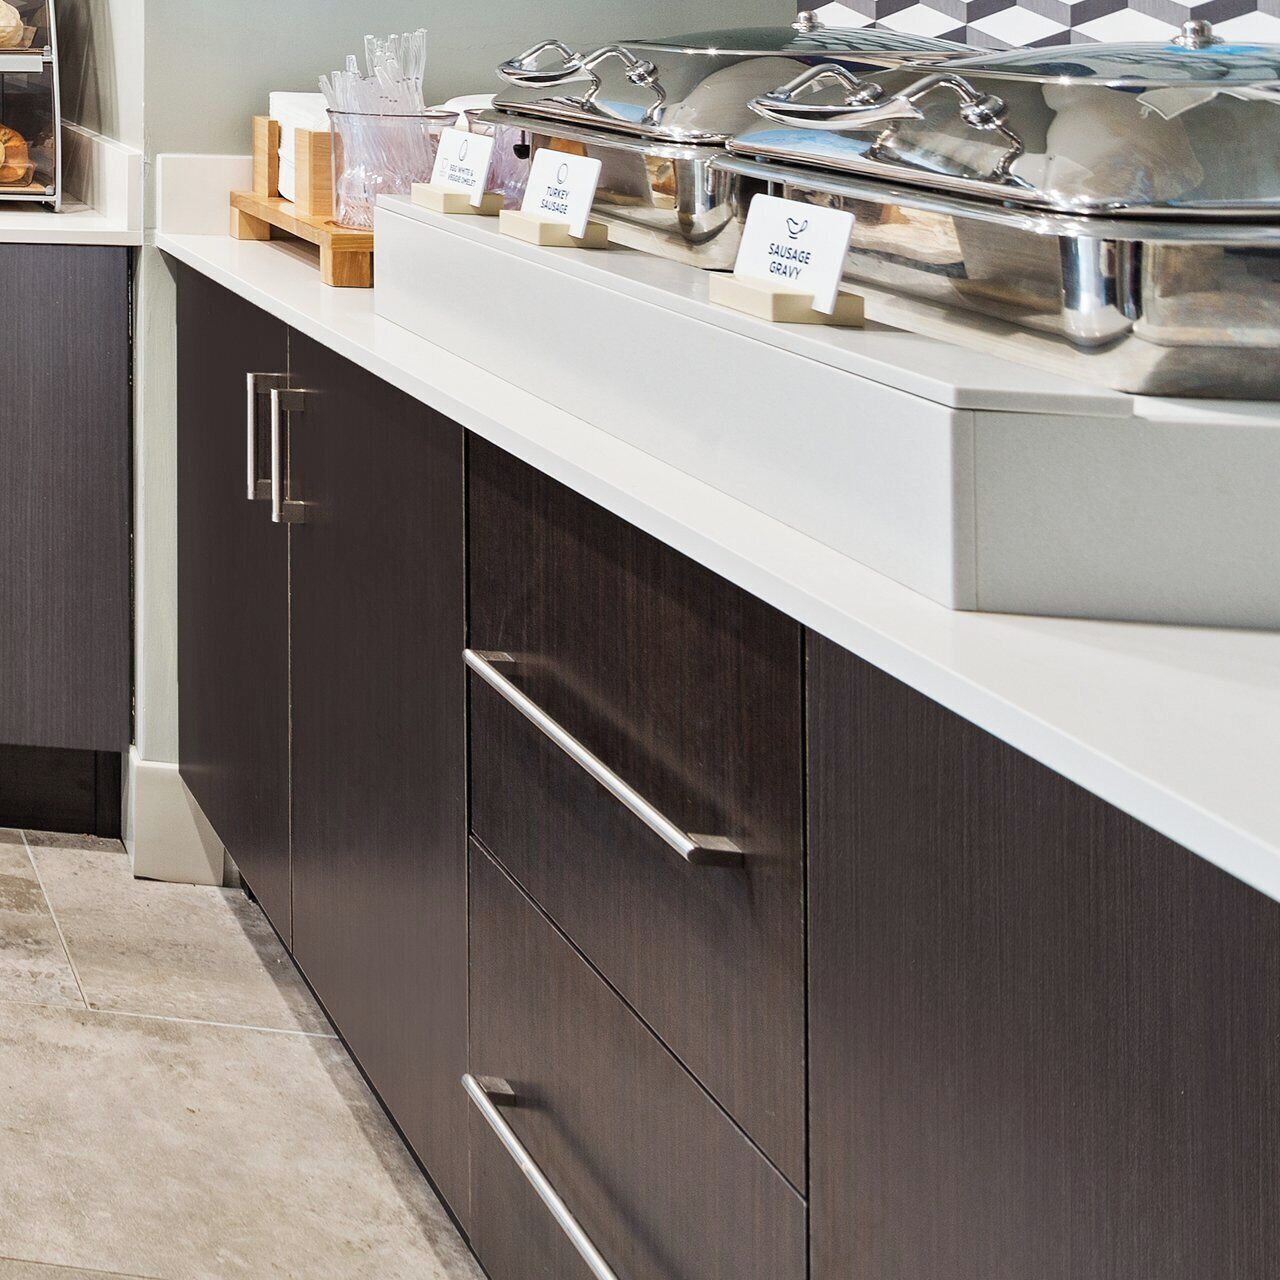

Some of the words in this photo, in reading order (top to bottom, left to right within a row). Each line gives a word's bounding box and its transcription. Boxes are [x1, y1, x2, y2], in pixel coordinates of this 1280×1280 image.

[547, 186, 570, 199] TURKEY
[540, 199, 568, 215] SAUSAGE
[768, 242, 811, 265] SAUSAGE
[769, 261, 802, 280] GRAVY
